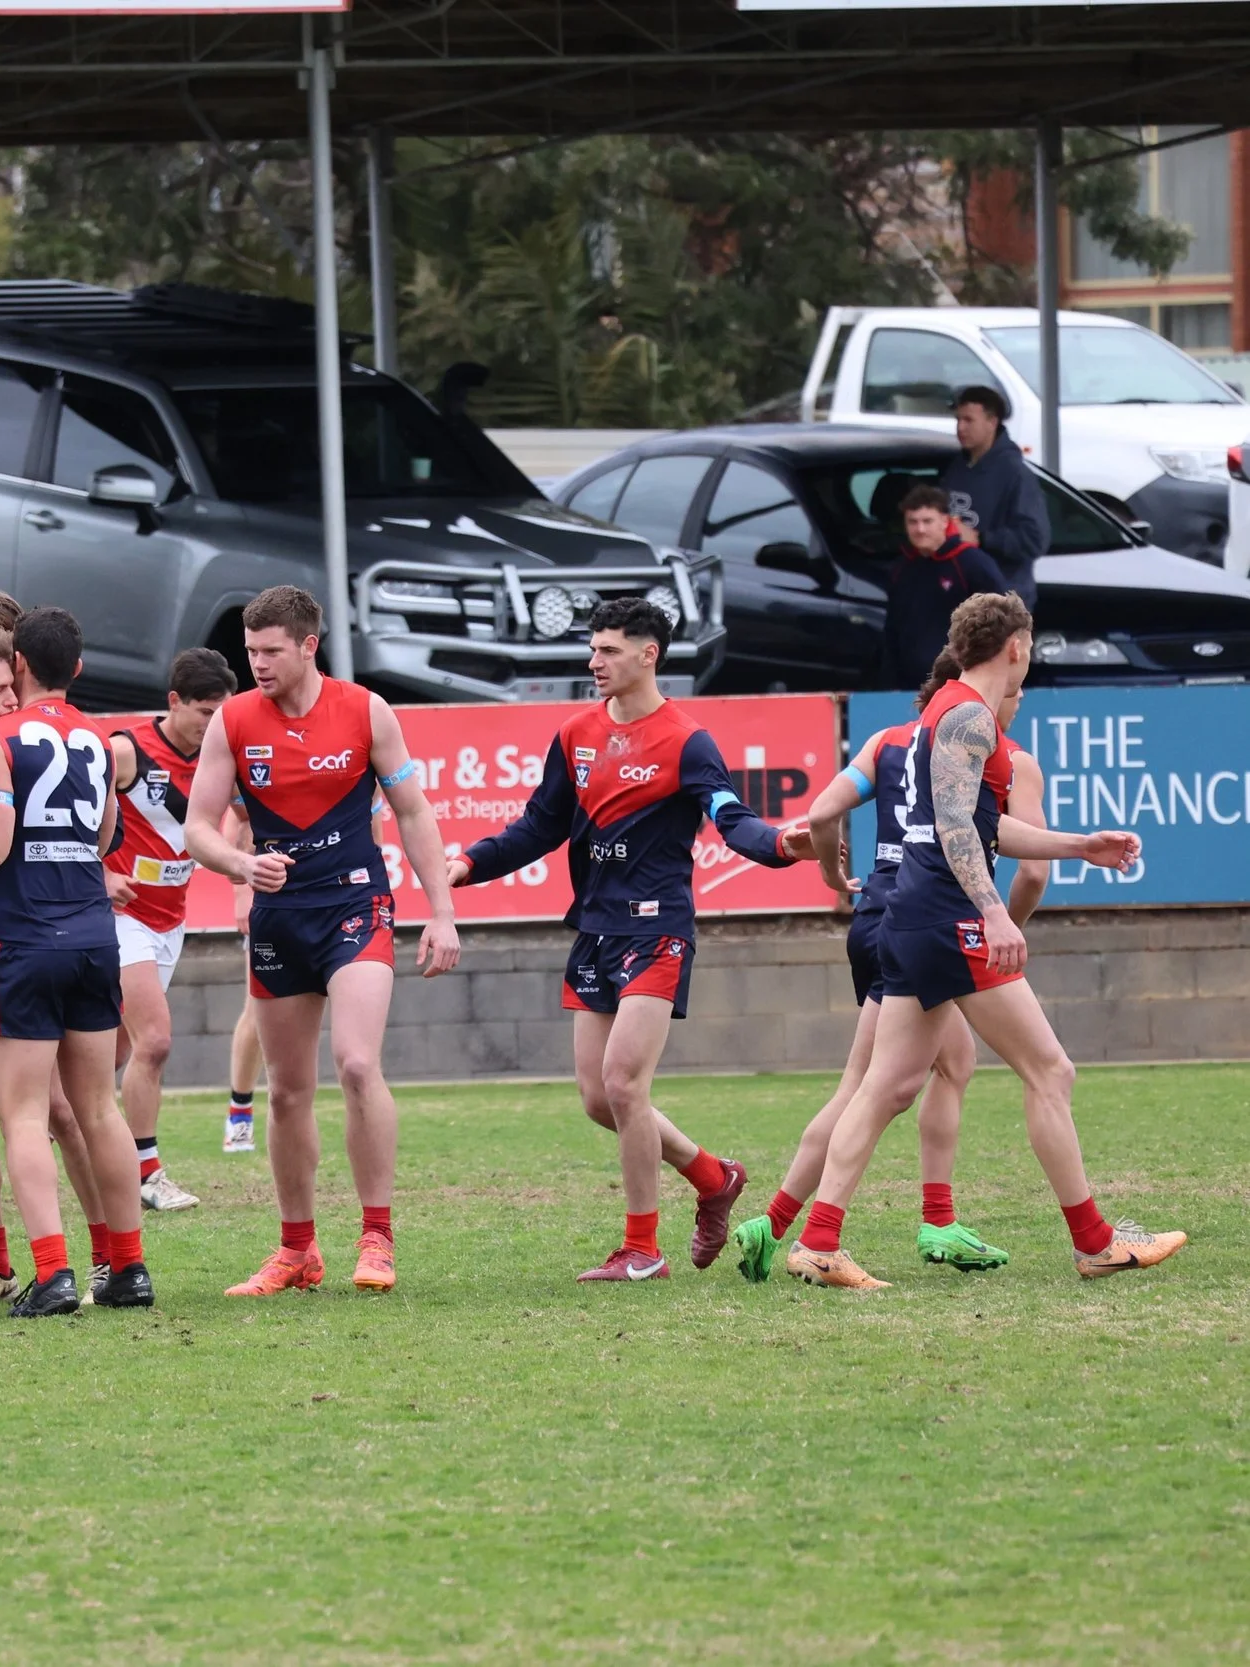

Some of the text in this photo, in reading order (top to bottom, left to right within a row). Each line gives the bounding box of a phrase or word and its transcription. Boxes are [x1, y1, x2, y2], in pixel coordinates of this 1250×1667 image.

[455, 746, 487, 790] &
[1047, 715, 1147, 769] THE
[19, 720, 107, 832] 23
[1050, 771, 1250, 827] FINANC
